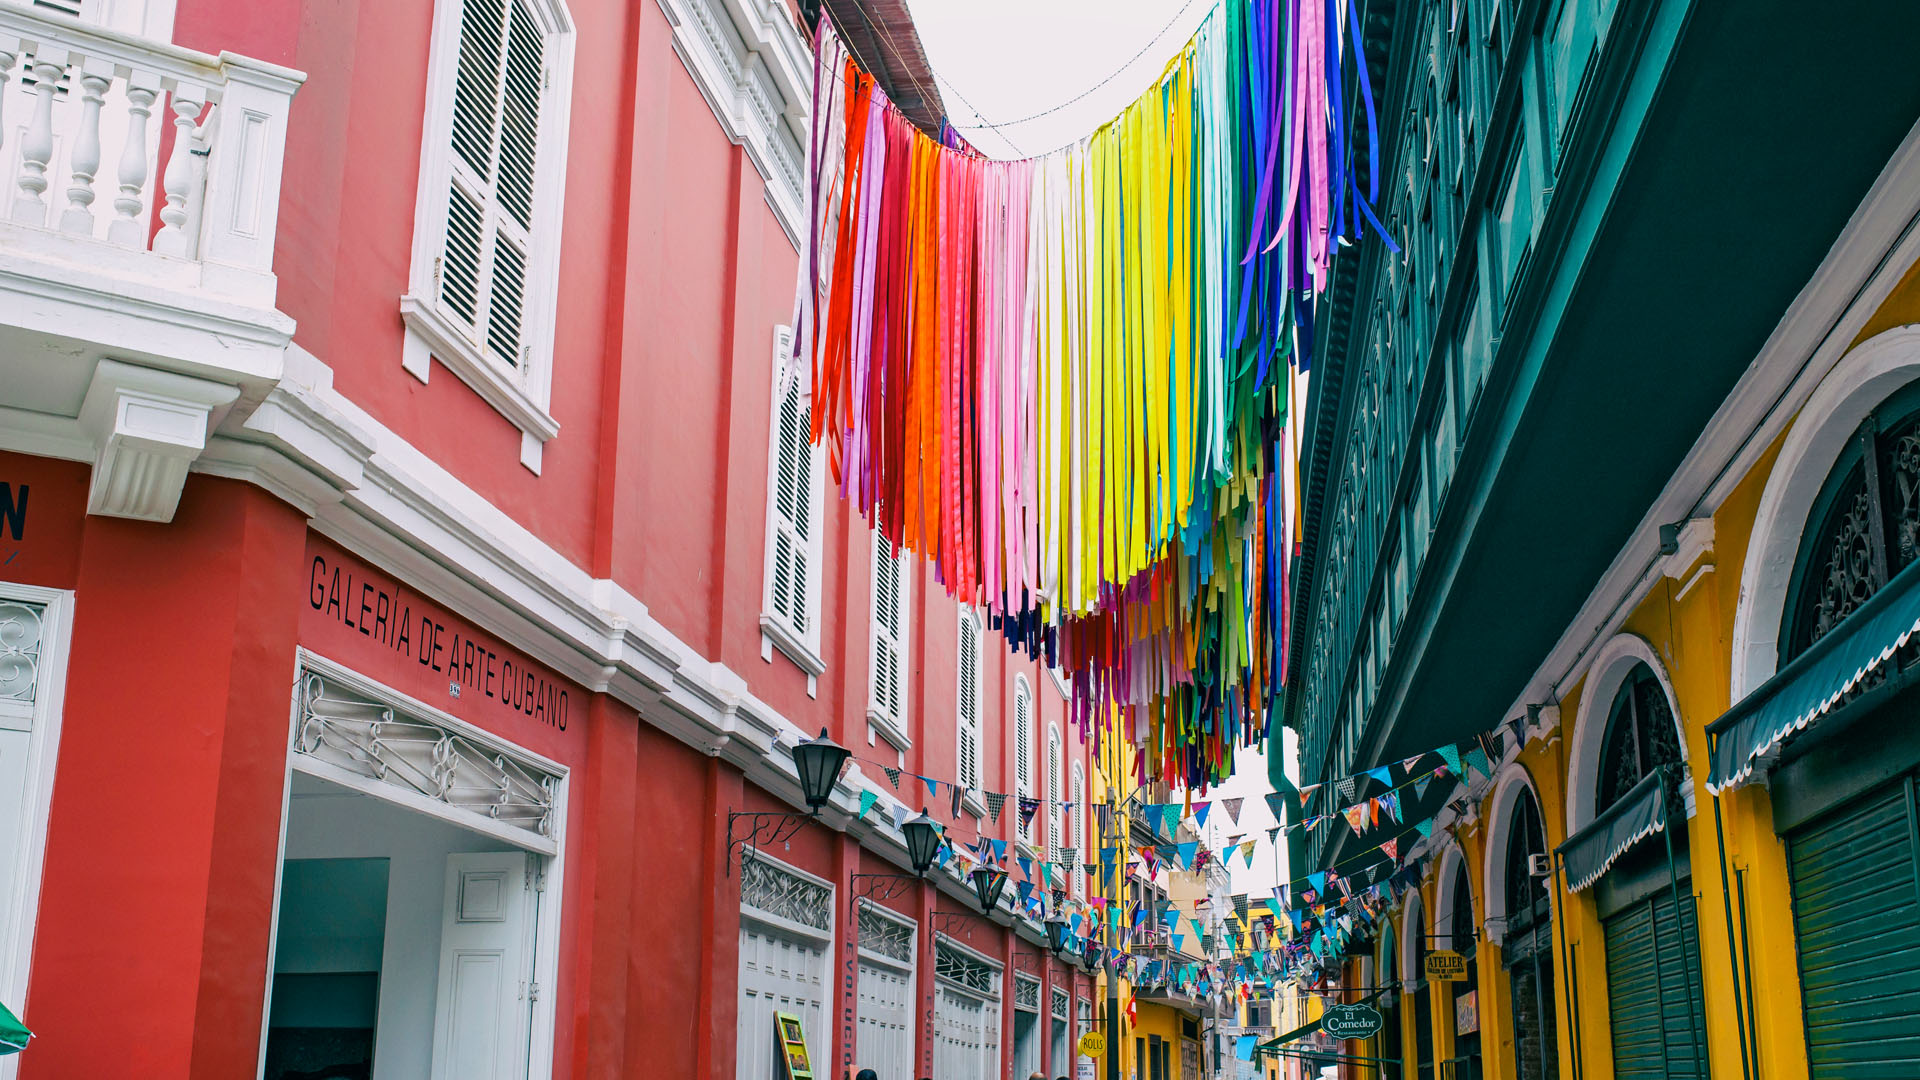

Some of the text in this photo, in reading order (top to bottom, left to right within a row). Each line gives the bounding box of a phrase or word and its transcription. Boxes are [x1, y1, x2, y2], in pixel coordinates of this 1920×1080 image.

[309, 555, 569, 732] GALERÍA DE ARTE CUBANO
[1427, 956, 1464, 968] ATELIER
[1344, 1011, 1354, 1020] El
[1327, 1017, 1376, 1031] Comedor
[1083, 1037, 1104, 1050] ROLLS
